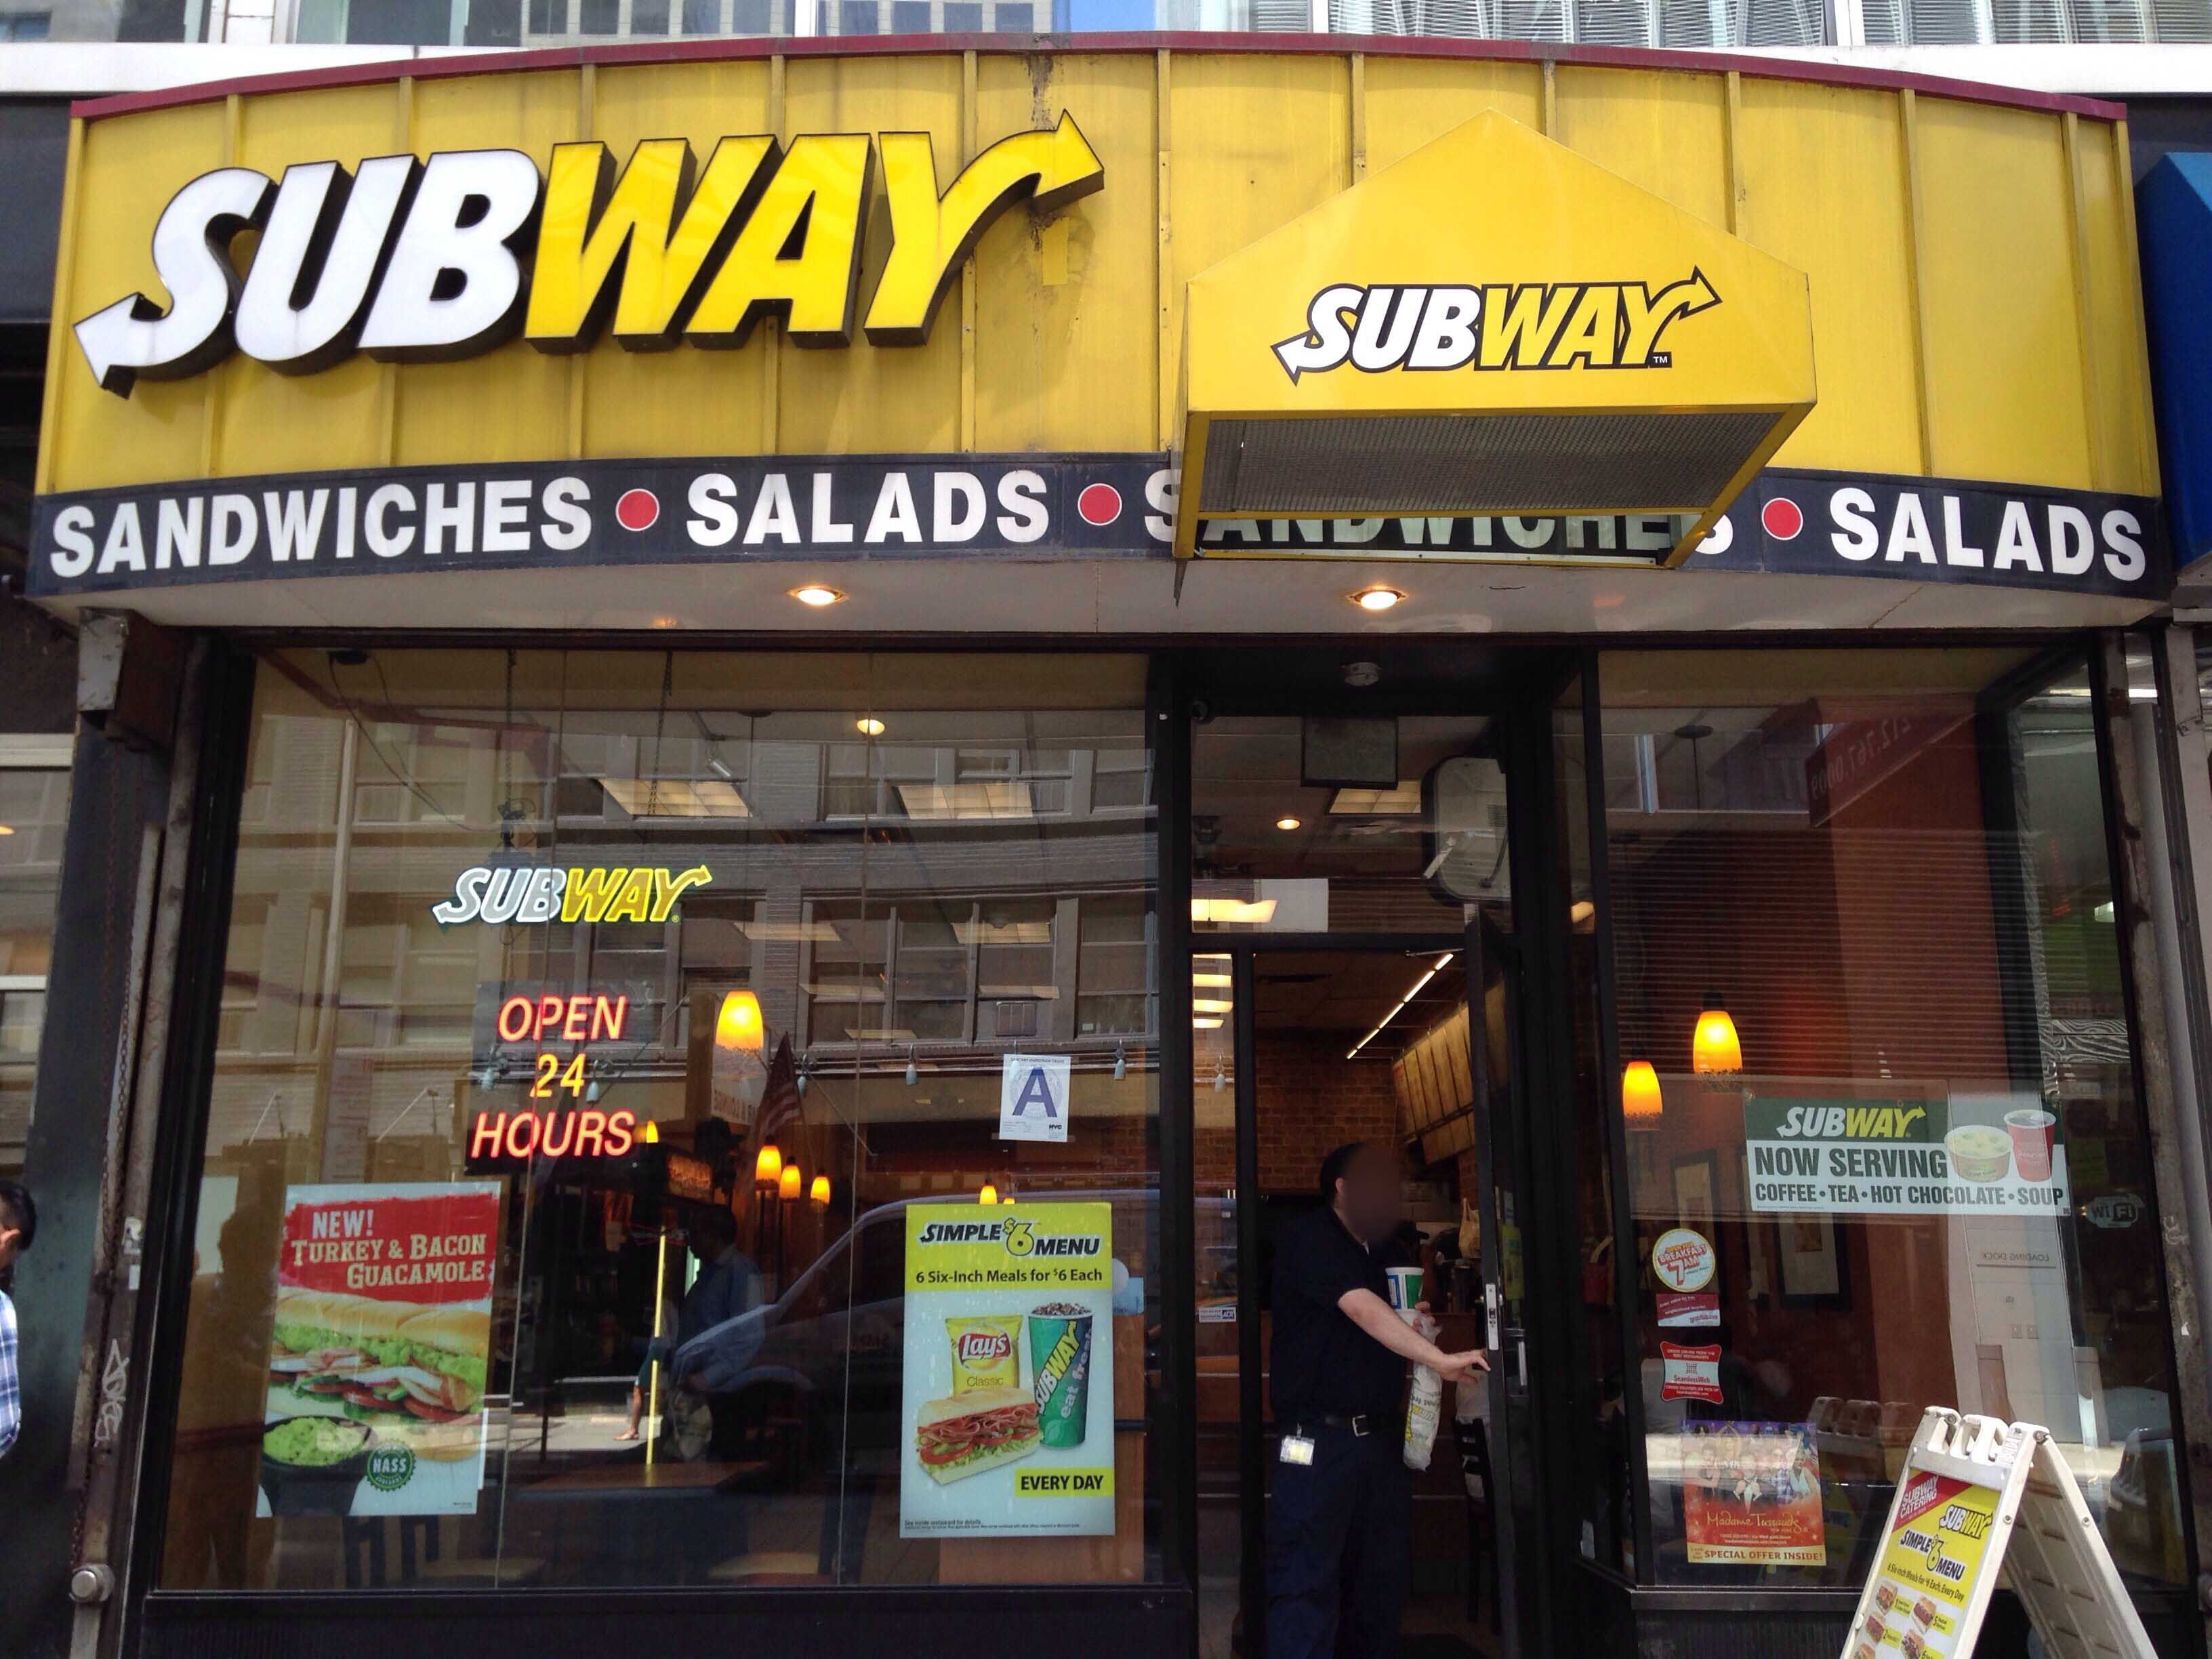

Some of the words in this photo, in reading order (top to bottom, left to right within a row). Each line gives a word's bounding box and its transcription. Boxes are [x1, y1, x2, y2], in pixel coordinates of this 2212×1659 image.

[73, 108, 1105, 389] SUBWAY
[1271, 265, 1722, 386] SUBWAY
[686, 469, 1050, 547] SALADS
[49, 476, 592, 578] SANDWICHES
[1829, 487, 2146, 581] SALADS
[432, 865, 712, 924] SUBWAY
[497, 994, 628, 1042] OPEN
[529, 1052, 587, 1098] 24
[1012, 1067, 1058, 1118] A
[470, 1108, 636, 1158] HOURS
[1776, 1105, 1926, 1139] SUBWAY
[1754, 1146, 1820, 1177] NOW
[1830, 1147, 1948, 1179] SERVING
[1755, 1183, 1818, 1202] COFFEE
[1828, 1184, 1860, 1204] TEA
[1870, 1185, 1903, 1204] HOT
[1908, 1186, 2006, 1206] CHOCOLATE
[2017, 1187, 2064, 1206] SOUP
[311, 1208, 374, 1240] NEW!
[920, 1223, 1002, 1243] SIMPLE
[1035, 1238, 1100, 1256] MENU
[291, 1237, 384, 1266] TURKEY
[388, 1238, 404, 1259] &
[409, 1233, 487, 1261] BACON
[1658, 1244, 1707, 1265] BREAKFAST
[346, 1259, 485, 1288] GUACAMOLE
[916, 1271, 925, 1284] 6
[928, 1269, 983, 1283] Six-Inch
[987, 1268, 1027, 1282] Meals
[1030, 1268, 1050, 1282] for
[1052, 1268, 1067, 1282] $6
[1070, 1267, 1103, 1282] Each
[1667, 1259, 1685, 1286] 7
[1684, 1256, 1700, 1269] AM
[962, 1332, 1010, 1360] Lay's
[966, 1375, 1004, 1388] Classic
[1036, 1321, 1080, 1416] SUBWAY
[1061, 1385, 1079, 1418] eat
[373, 1457, 407, 1473] HASS
[1021, 1475, 1069, 1491] EVERY
[1073, 1475, 1104, 1490] DAY
[1902, 1475, 1939, 1507] SUBWAY
[1706, 1511, 1752, 1528] Madame
[1900, 1488, 1938, 1519] CATERING
[1939, 1504, 1993, 1540] SUBWAY
[1704, 1550, 1746, 1559] SPECIAL
[1749, 1551, 1781, 1560] OFFER
[1784, 1551, 1823, 1561] INSIDE!
[1900, 1529, 1933, 1553] SIMPLE
[1935, 1557, 1965, 1581] MENU
[1941, 1584, 1955, 1599] Every
[1954, 1589, 1965, 1603] Day
